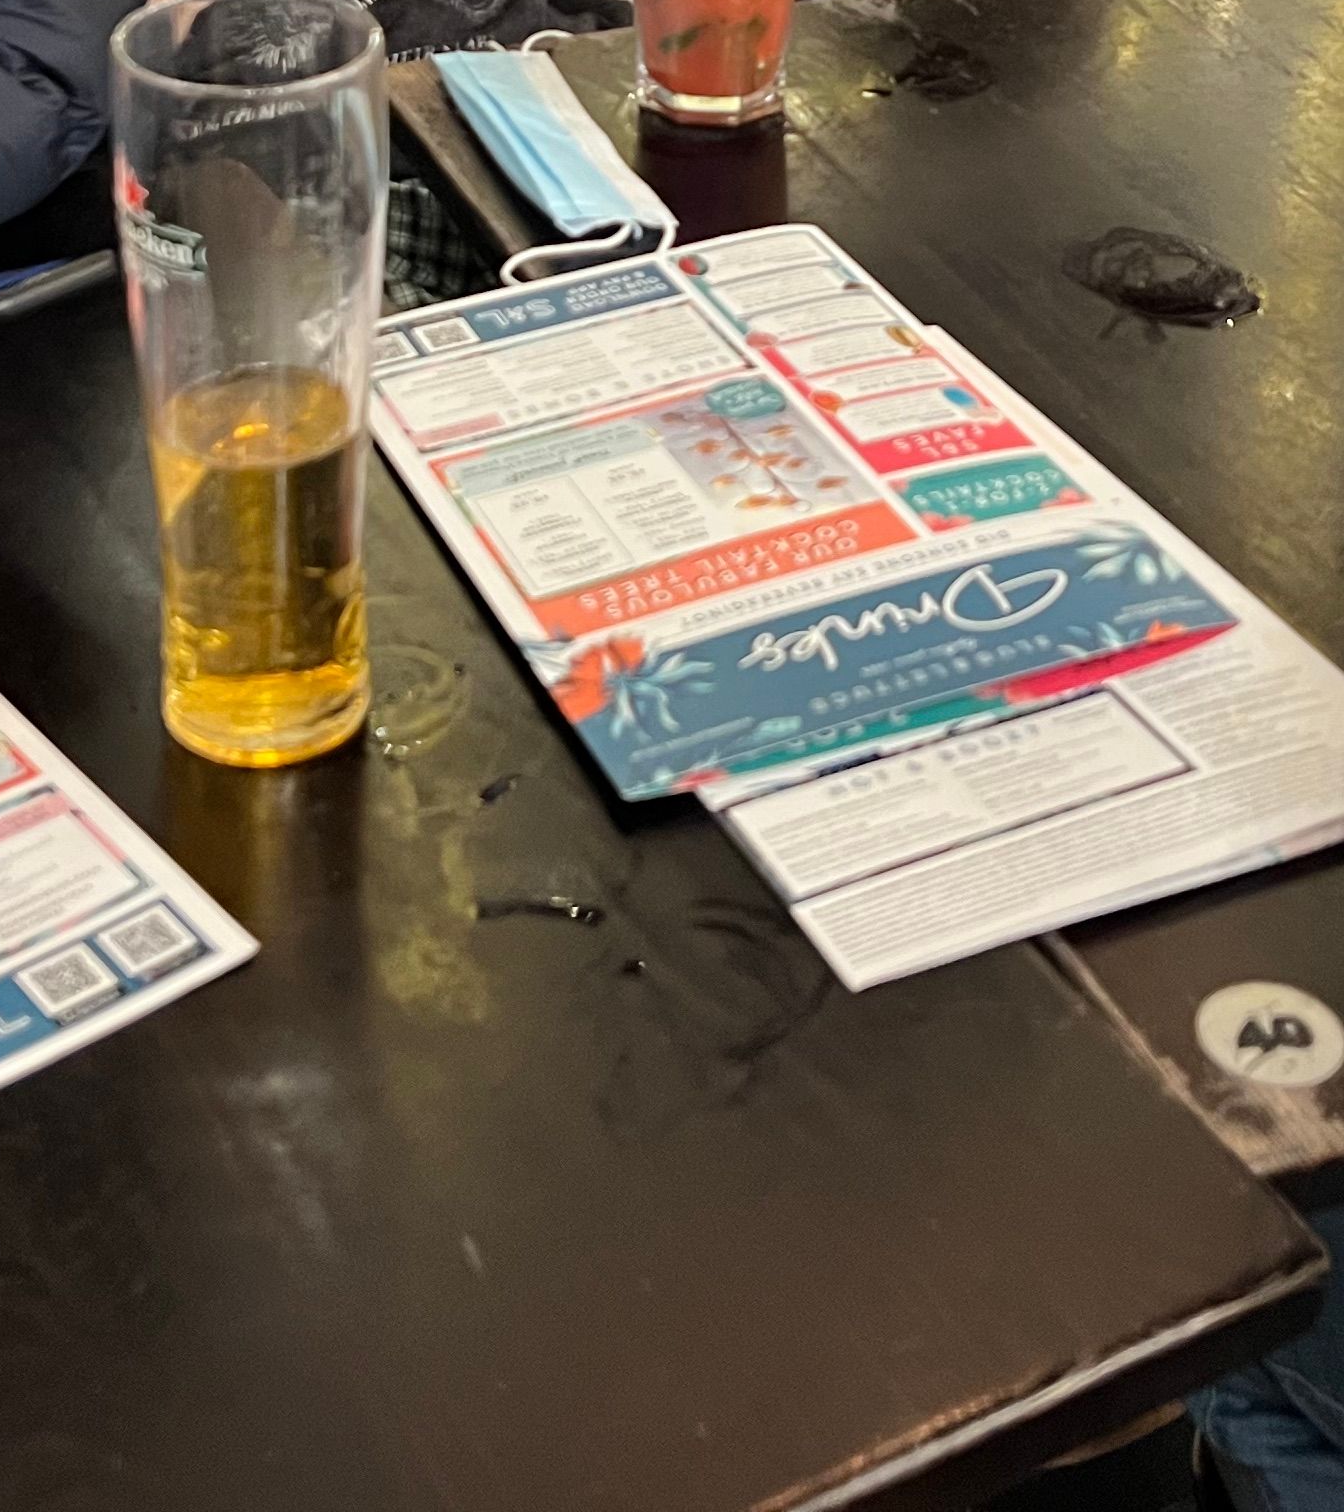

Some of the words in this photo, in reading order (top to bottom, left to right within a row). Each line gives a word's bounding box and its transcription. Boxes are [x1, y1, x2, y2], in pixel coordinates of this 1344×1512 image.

[472, 297, 558, 329] S&L
[912, 467, 1060, 509] COCKTAILS
[692, 516, 863, 576] COCKTAIL
[787, 534, 861, 565] OUR
[575, 567, 684, 609] TREES
[601, 556, 782, 619] FABULOUS
[739, 563, 1068, 673] Drinks
